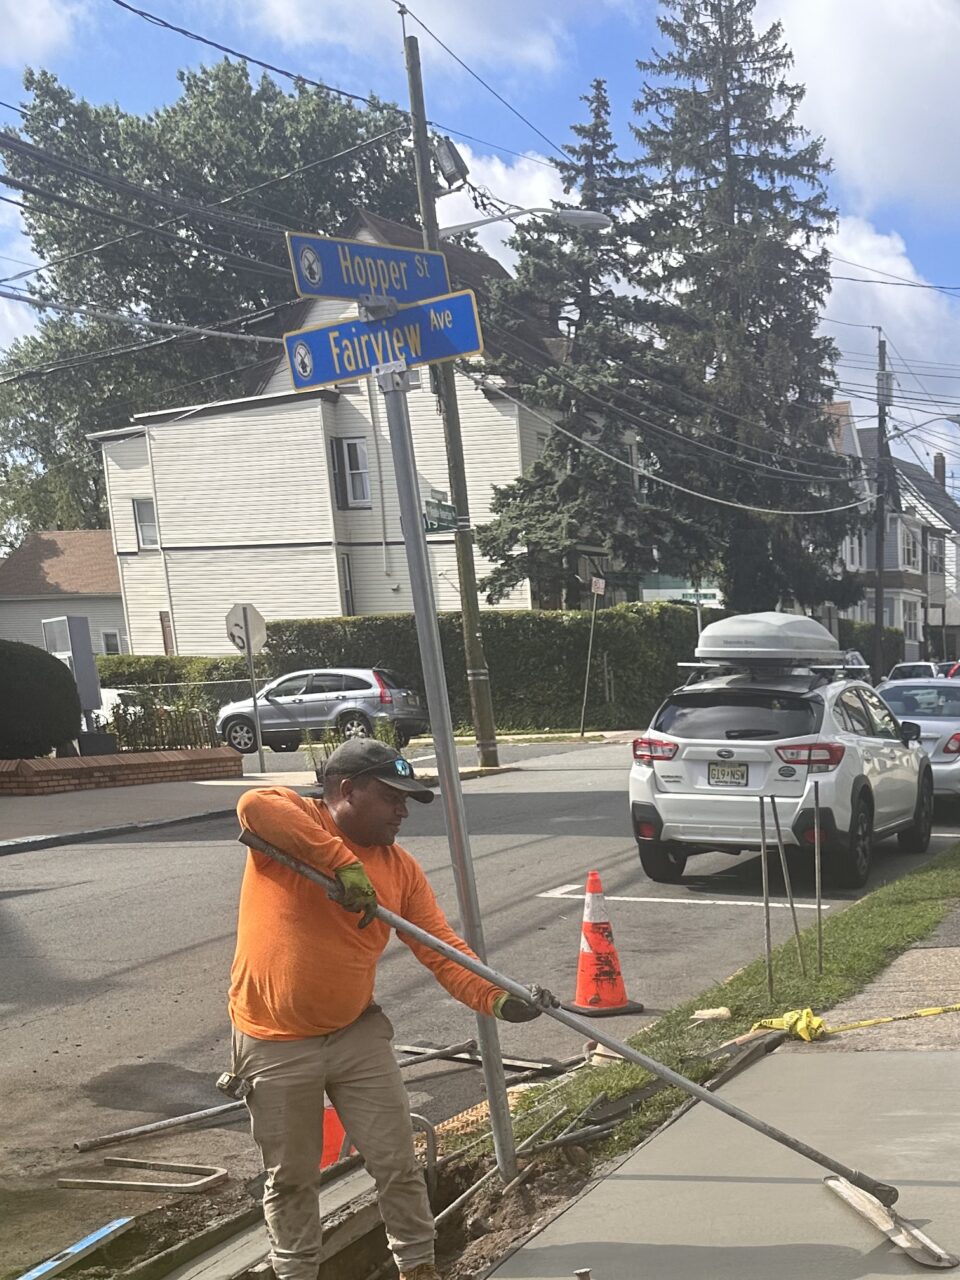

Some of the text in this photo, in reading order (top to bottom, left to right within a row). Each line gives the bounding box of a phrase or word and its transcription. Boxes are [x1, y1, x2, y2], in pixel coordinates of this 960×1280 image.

[337, 244, 430, 296] Hopper St
[328, 308, 453, 375] Fairview Ave
